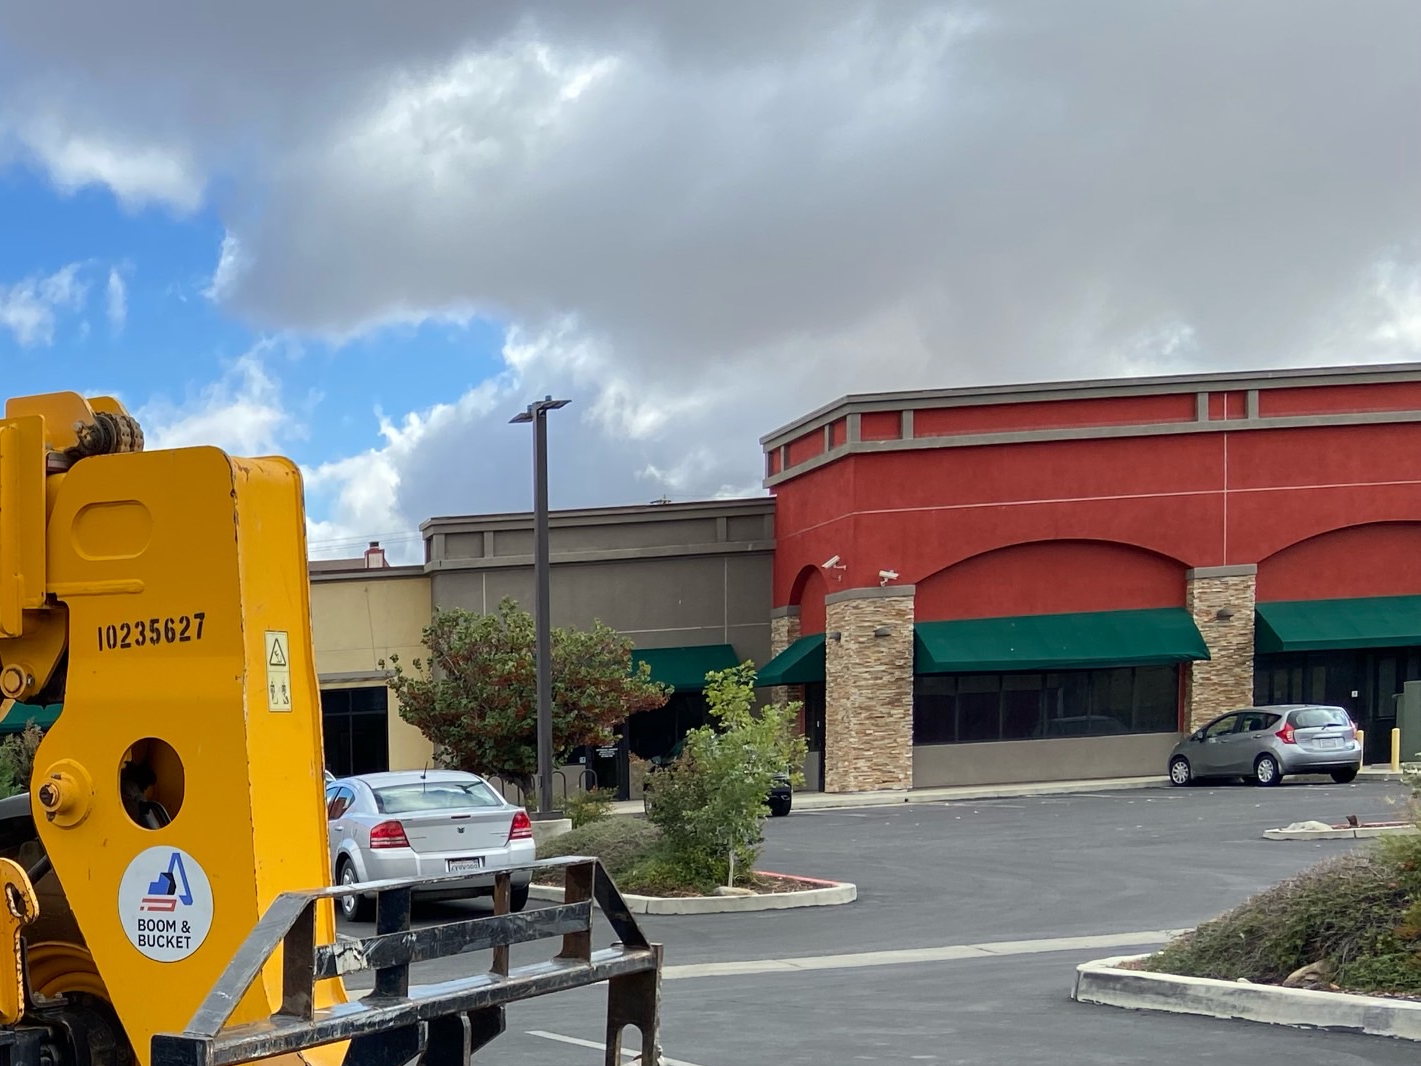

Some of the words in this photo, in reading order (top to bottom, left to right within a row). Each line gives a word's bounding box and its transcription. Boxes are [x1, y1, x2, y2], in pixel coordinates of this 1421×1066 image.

[97, 612, 206, 652] 10235627
[137, 918, 177, 933] BOOM
[180, 920, 192, 934] &
[137, 933, 192, 950] BUCKET
